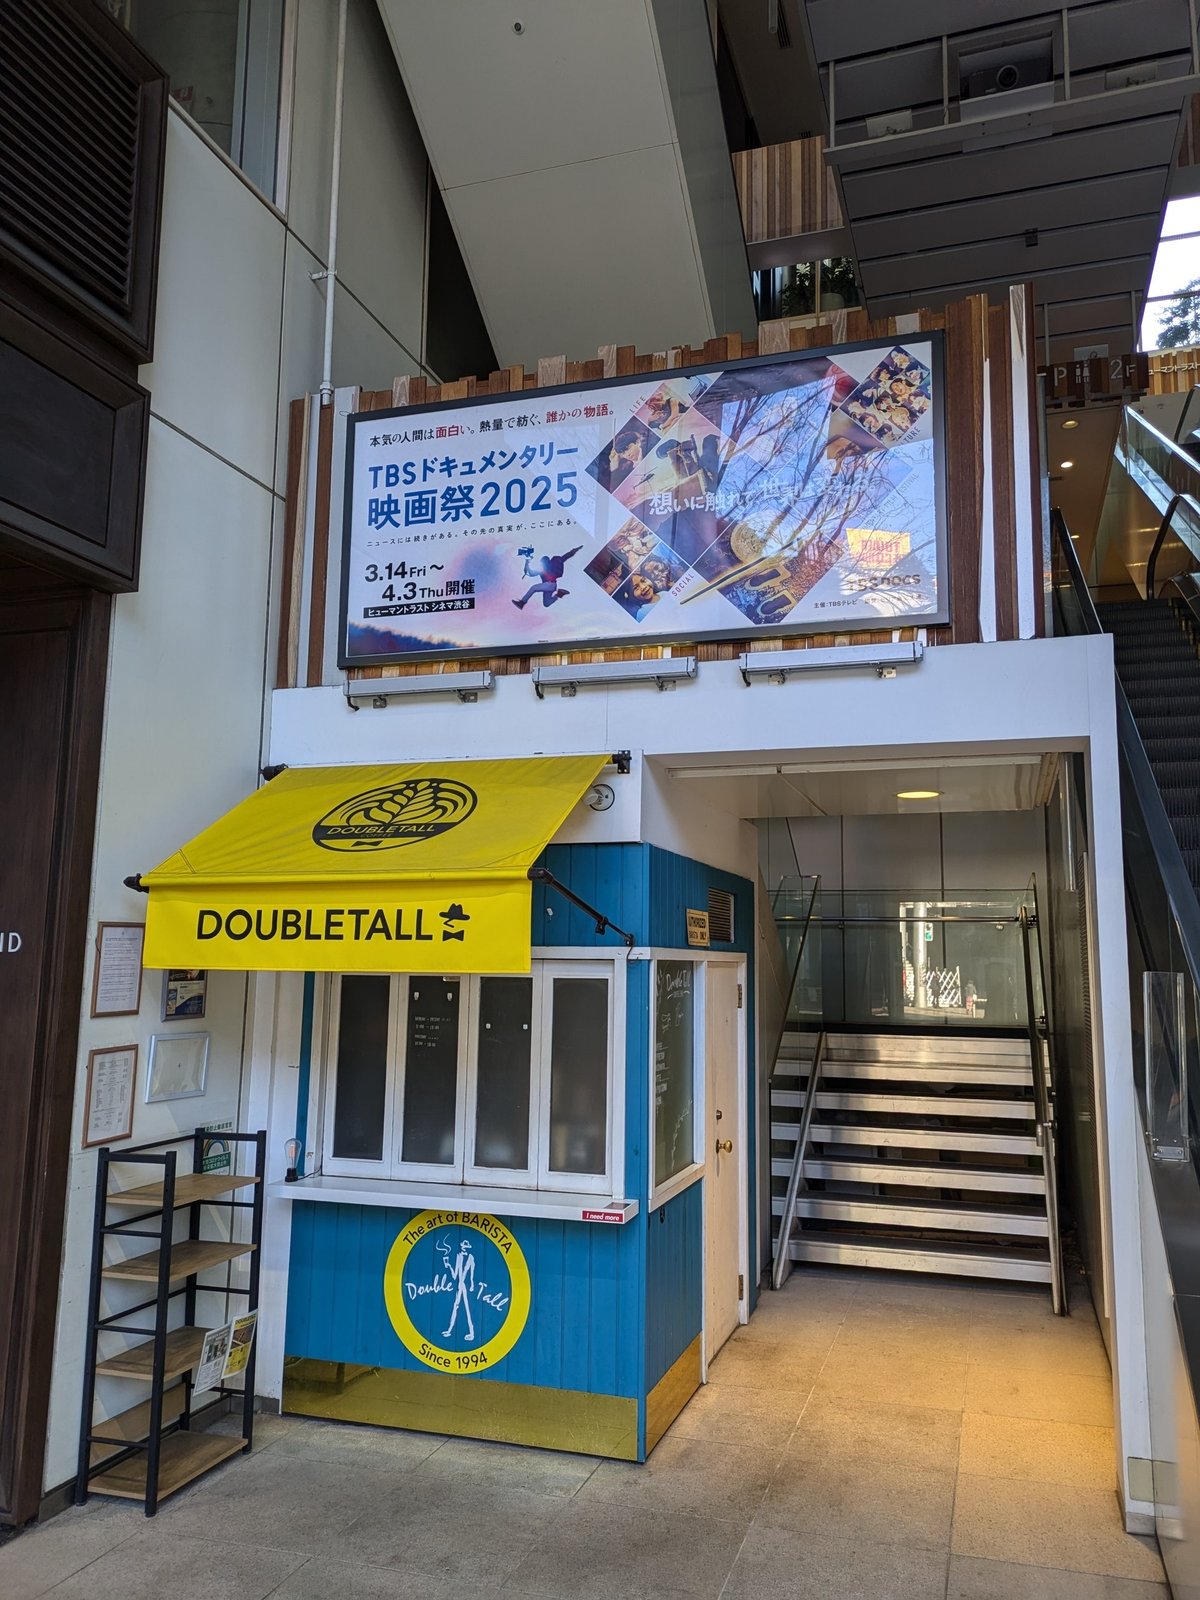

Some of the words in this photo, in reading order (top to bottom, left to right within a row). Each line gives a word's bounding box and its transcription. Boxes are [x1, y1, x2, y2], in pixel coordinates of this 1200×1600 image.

[368, 442, 578, 489] TBSドキュメンタリー
[367, 471, 578, 530] 映画祭2025
[671, 573, 695, 597] SOCIAL
[326, 824, 436, 835] DOUBLETALL
[197, 909, 433, 940] DOUBLETALL
[403, 1225, 425, 1246] The
[426, 1213, 444, 1230] art
[446, 1211, 459, 1223] of
[462, 1211, 513, 1255] BARISTA
[405, 1274, 453, 1300] Double
[477, 1282, 509, 1311] Tall
[418, 1343, 451, 1368] Since
[455, 1351, 488, 1370] 1994
